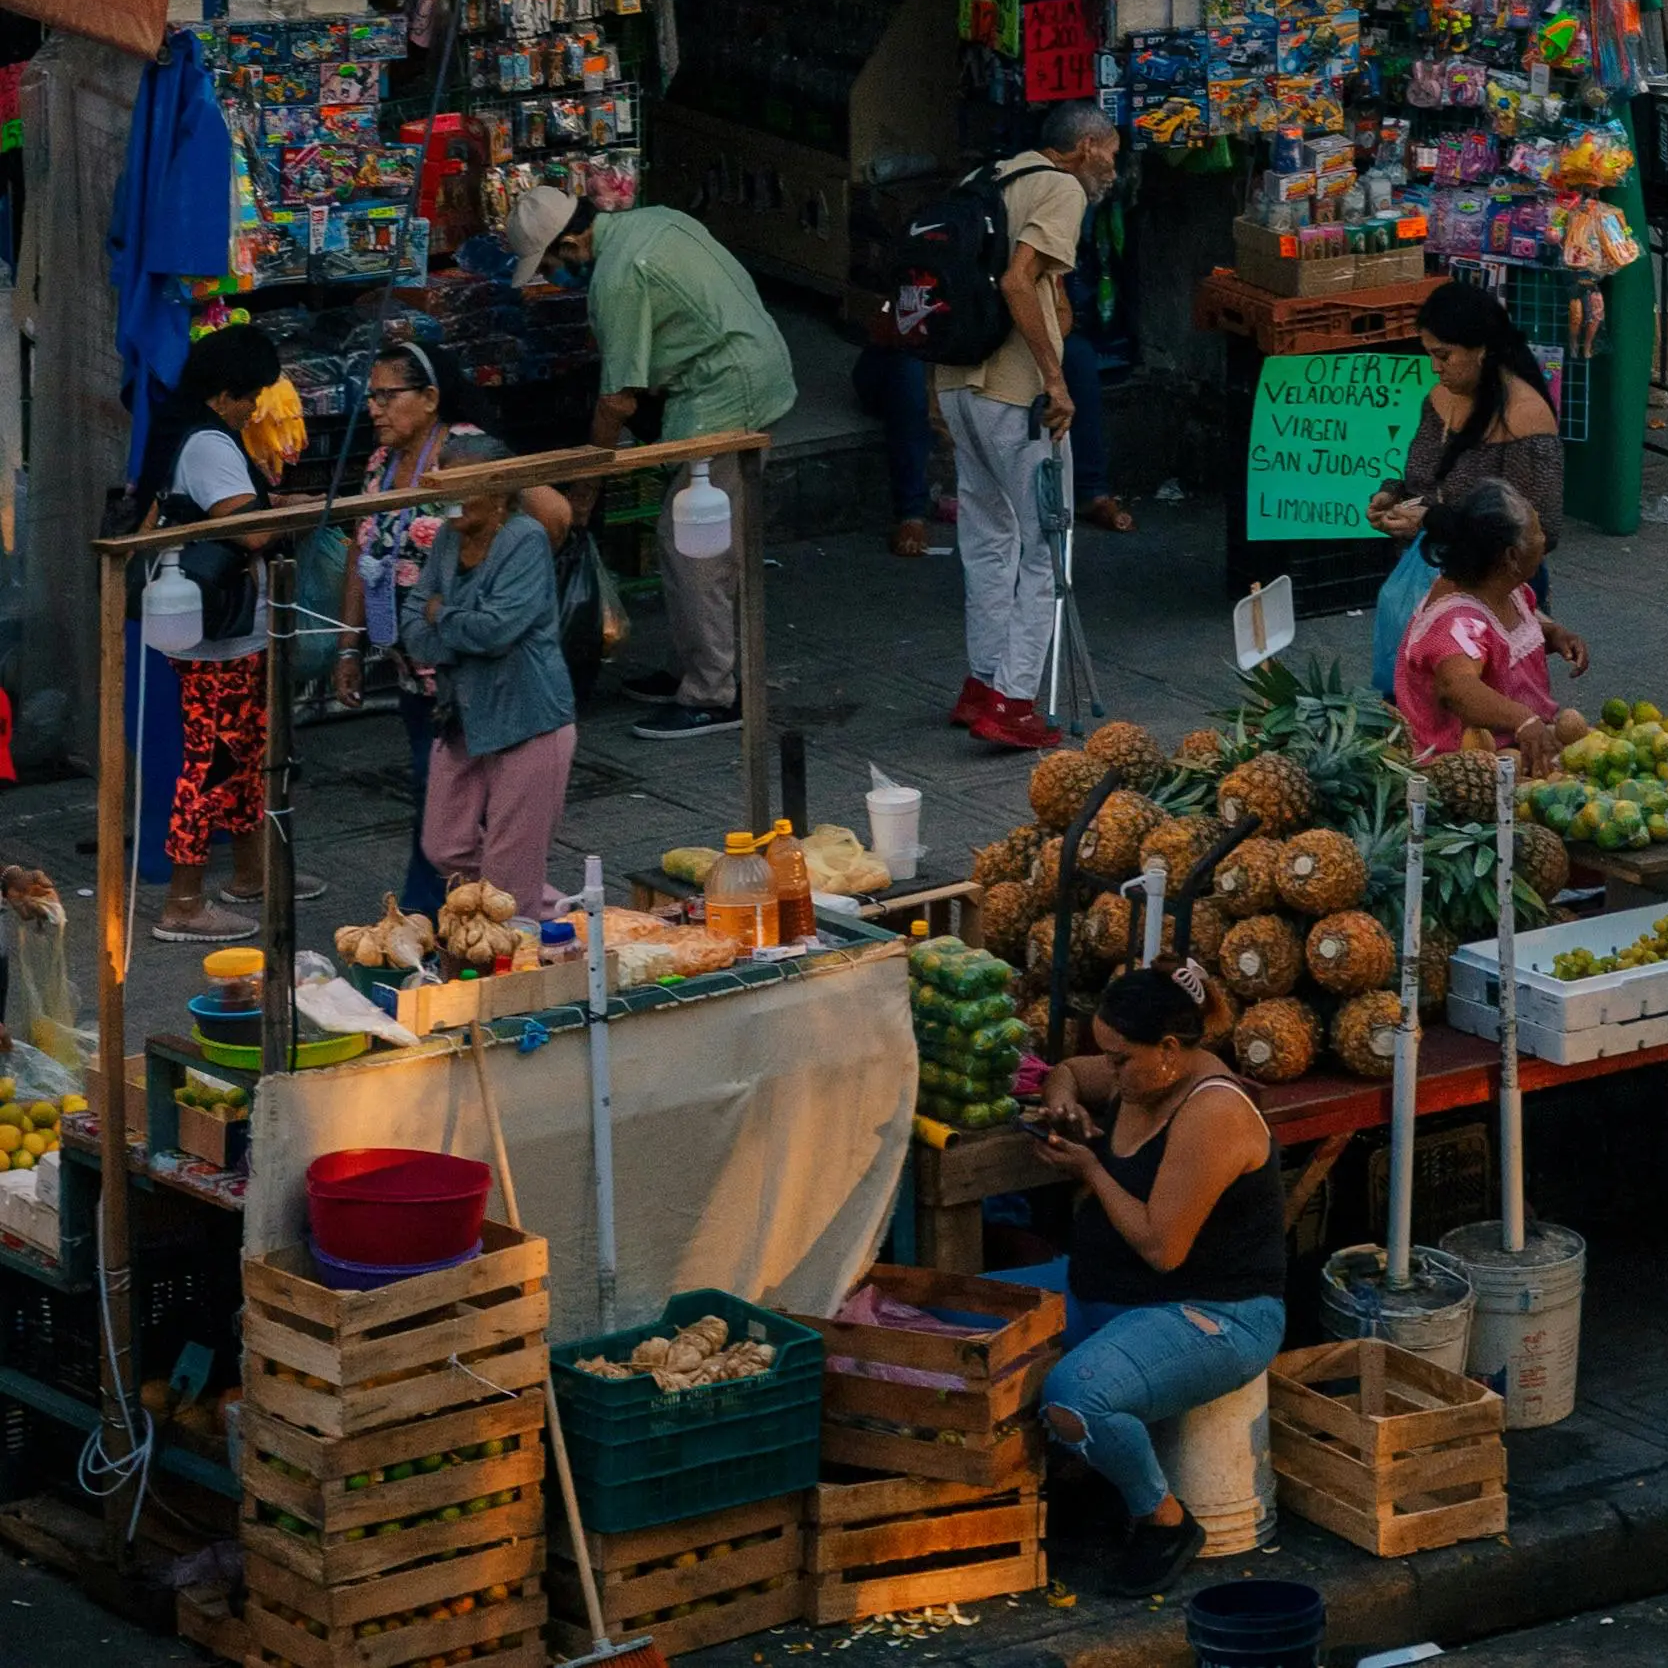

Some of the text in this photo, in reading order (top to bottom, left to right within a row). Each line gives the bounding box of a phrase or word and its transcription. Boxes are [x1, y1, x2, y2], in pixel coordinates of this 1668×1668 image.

[1304, 354, 1423, 385] OFERTA
[1264, 380, 1402, 408] VELADORAS:
[1272, 414, 1348, 441] VIRGEN
[1251, 445, 1302, 472] SAN
[1307, 449, 1382, 478] JUDAS
[1260, 491, 1361, 527] LIMONERO
